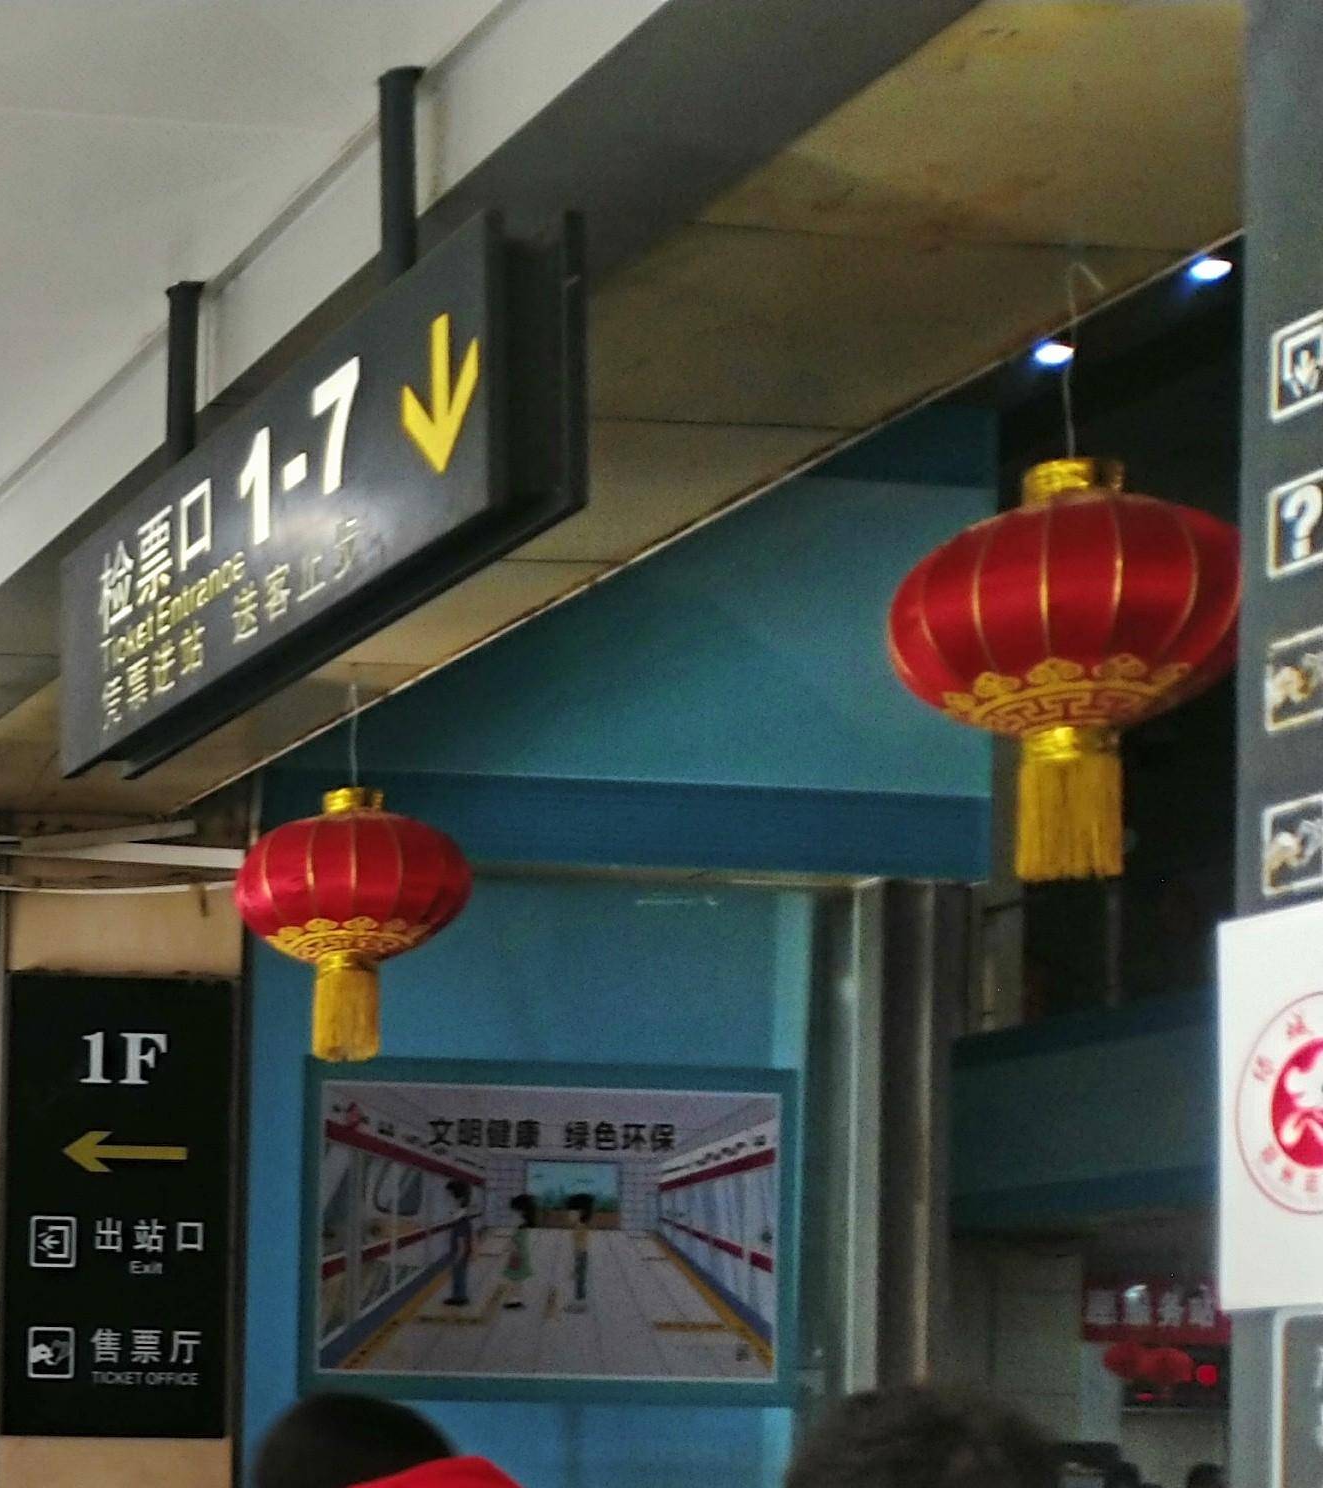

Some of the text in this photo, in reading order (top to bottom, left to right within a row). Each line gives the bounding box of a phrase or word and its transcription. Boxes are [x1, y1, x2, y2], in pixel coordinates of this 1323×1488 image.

[98, 356, 360, 634] 检票口 1-7
[231, 518, 359, 644] 送客止步
[100, 551, 247, 671] Ticket Entrance
[79, 1032, 168, 1085] 1F
[429, 1117, 542, 1151] 文明健康
[563, 1120, 677, 1153] 绿色环保
[95, 1217, 205, 1254] 出站口
[129, 1259, 164, 1275] Exit
[90, 1328, 203, 1366] 售票厅
[92, 1370, 199, 1387] TICKET OFFICE
